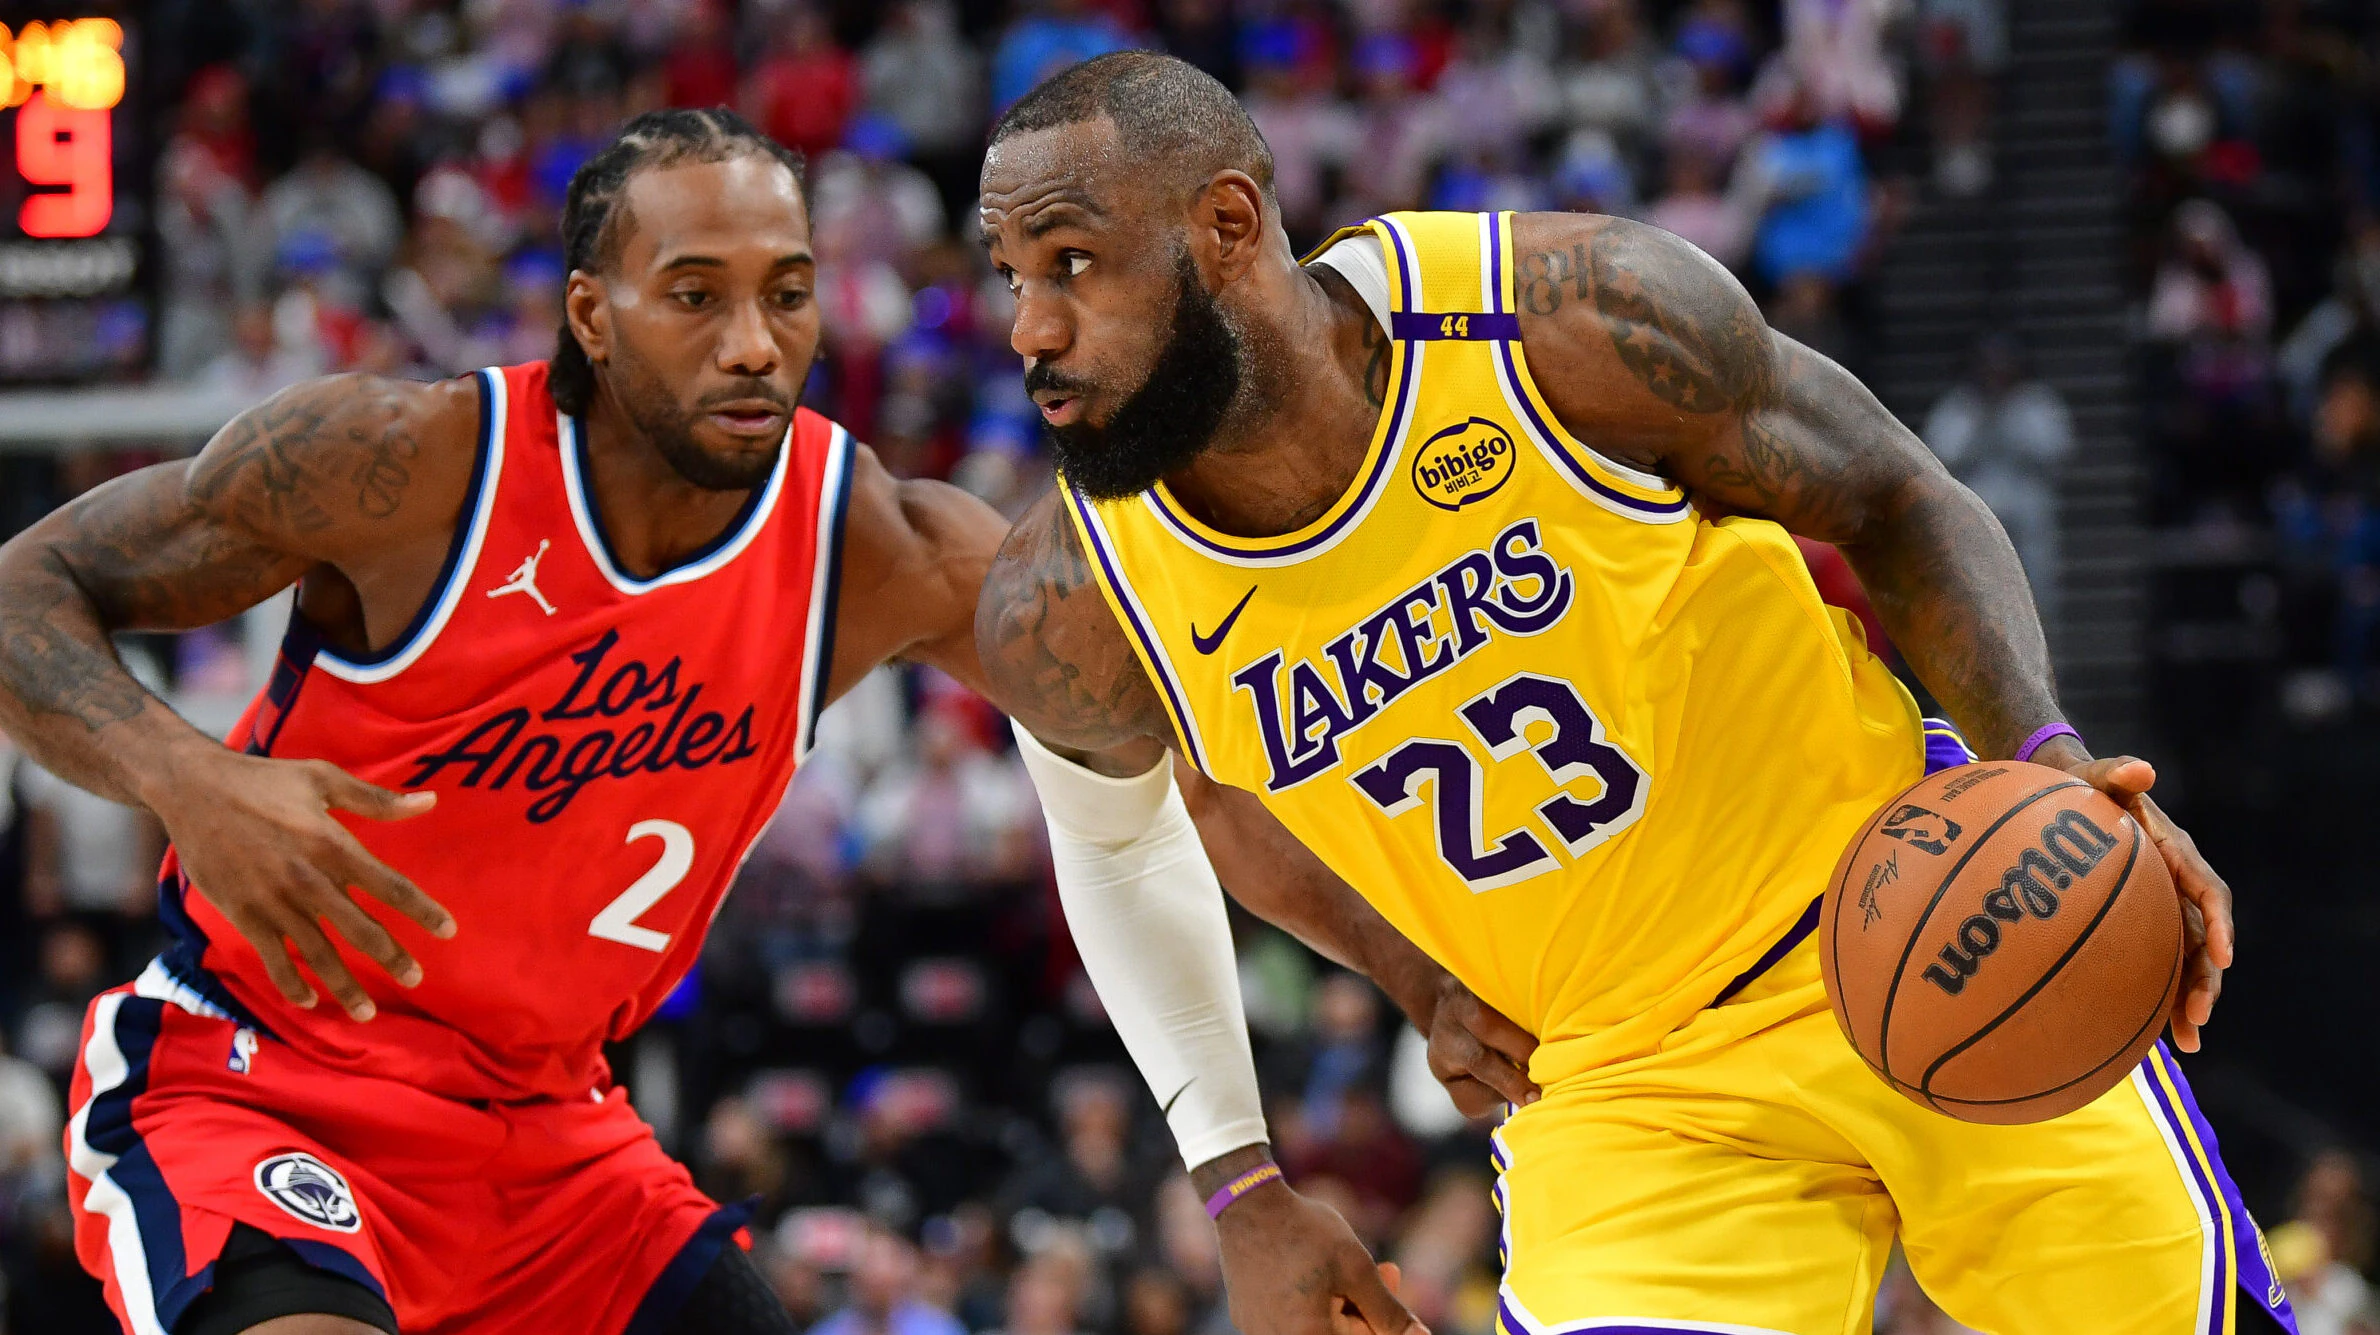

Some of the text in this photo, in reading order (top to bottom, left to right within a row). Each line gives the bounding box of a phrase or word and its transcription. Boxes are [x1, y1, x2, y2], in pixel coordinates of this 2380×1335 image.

[16, 86, 113, 238] 9
[1440, 316, 1469, 337] 44
[1418, 436, 1507, 489] bibigo
[1444, 470, 1482, 494] 비비고
[541, 628, 682, 721] Los
[1229, 517, 1576, 795] LAKERS
[401, 682, 760, 824] Angeles
[1345, 671, 1652, 894] 23
[588, 818, 695, 952] 2
[1921, 809, 2119, 996] Wilson
